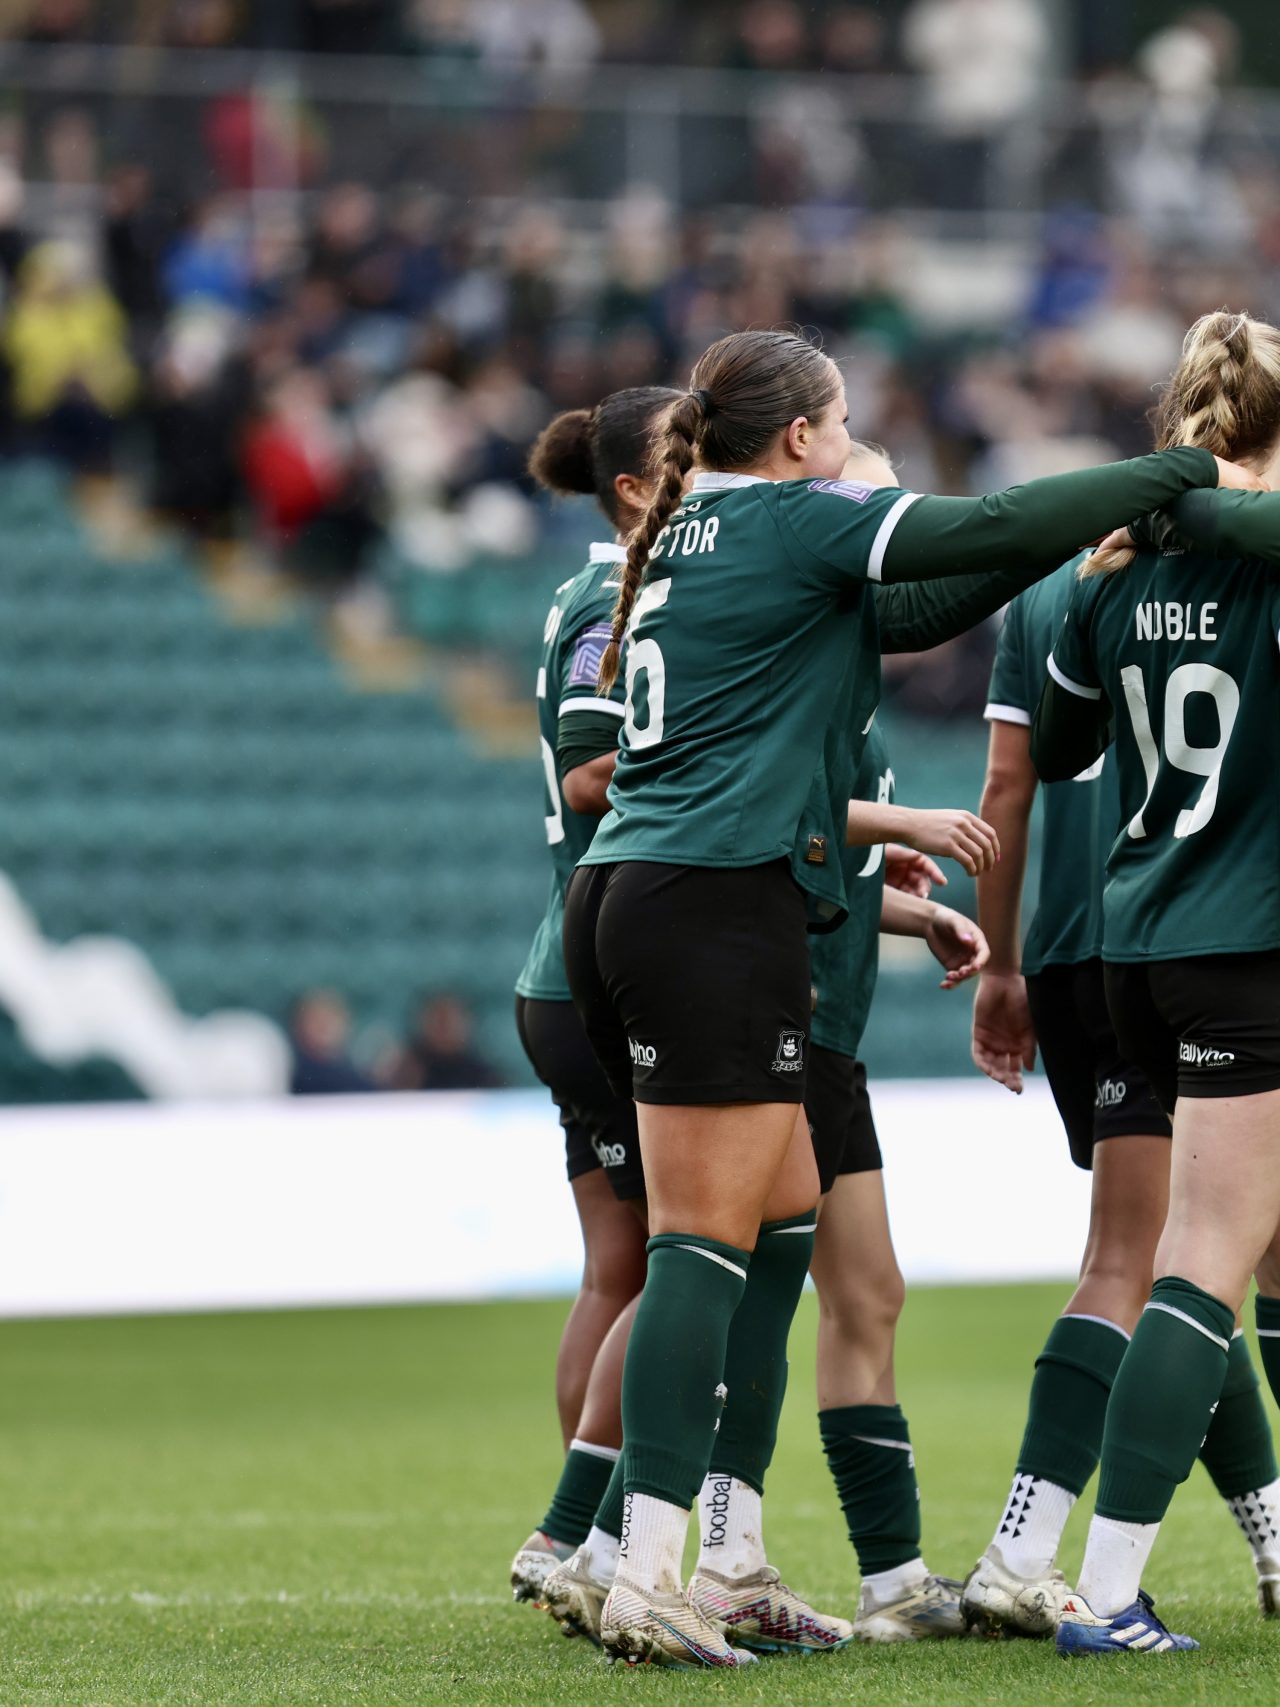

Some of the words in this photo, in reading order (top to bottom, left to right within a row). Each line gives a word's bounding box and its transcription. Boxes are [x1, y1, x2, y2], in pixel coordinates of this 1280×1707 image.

[648, 516, 720, 561] CTOR
[625, 576, 672, 750] 6
[1135, 601, 1219, 641] NOBLE
[1120, 662, 1240, 839] 19
